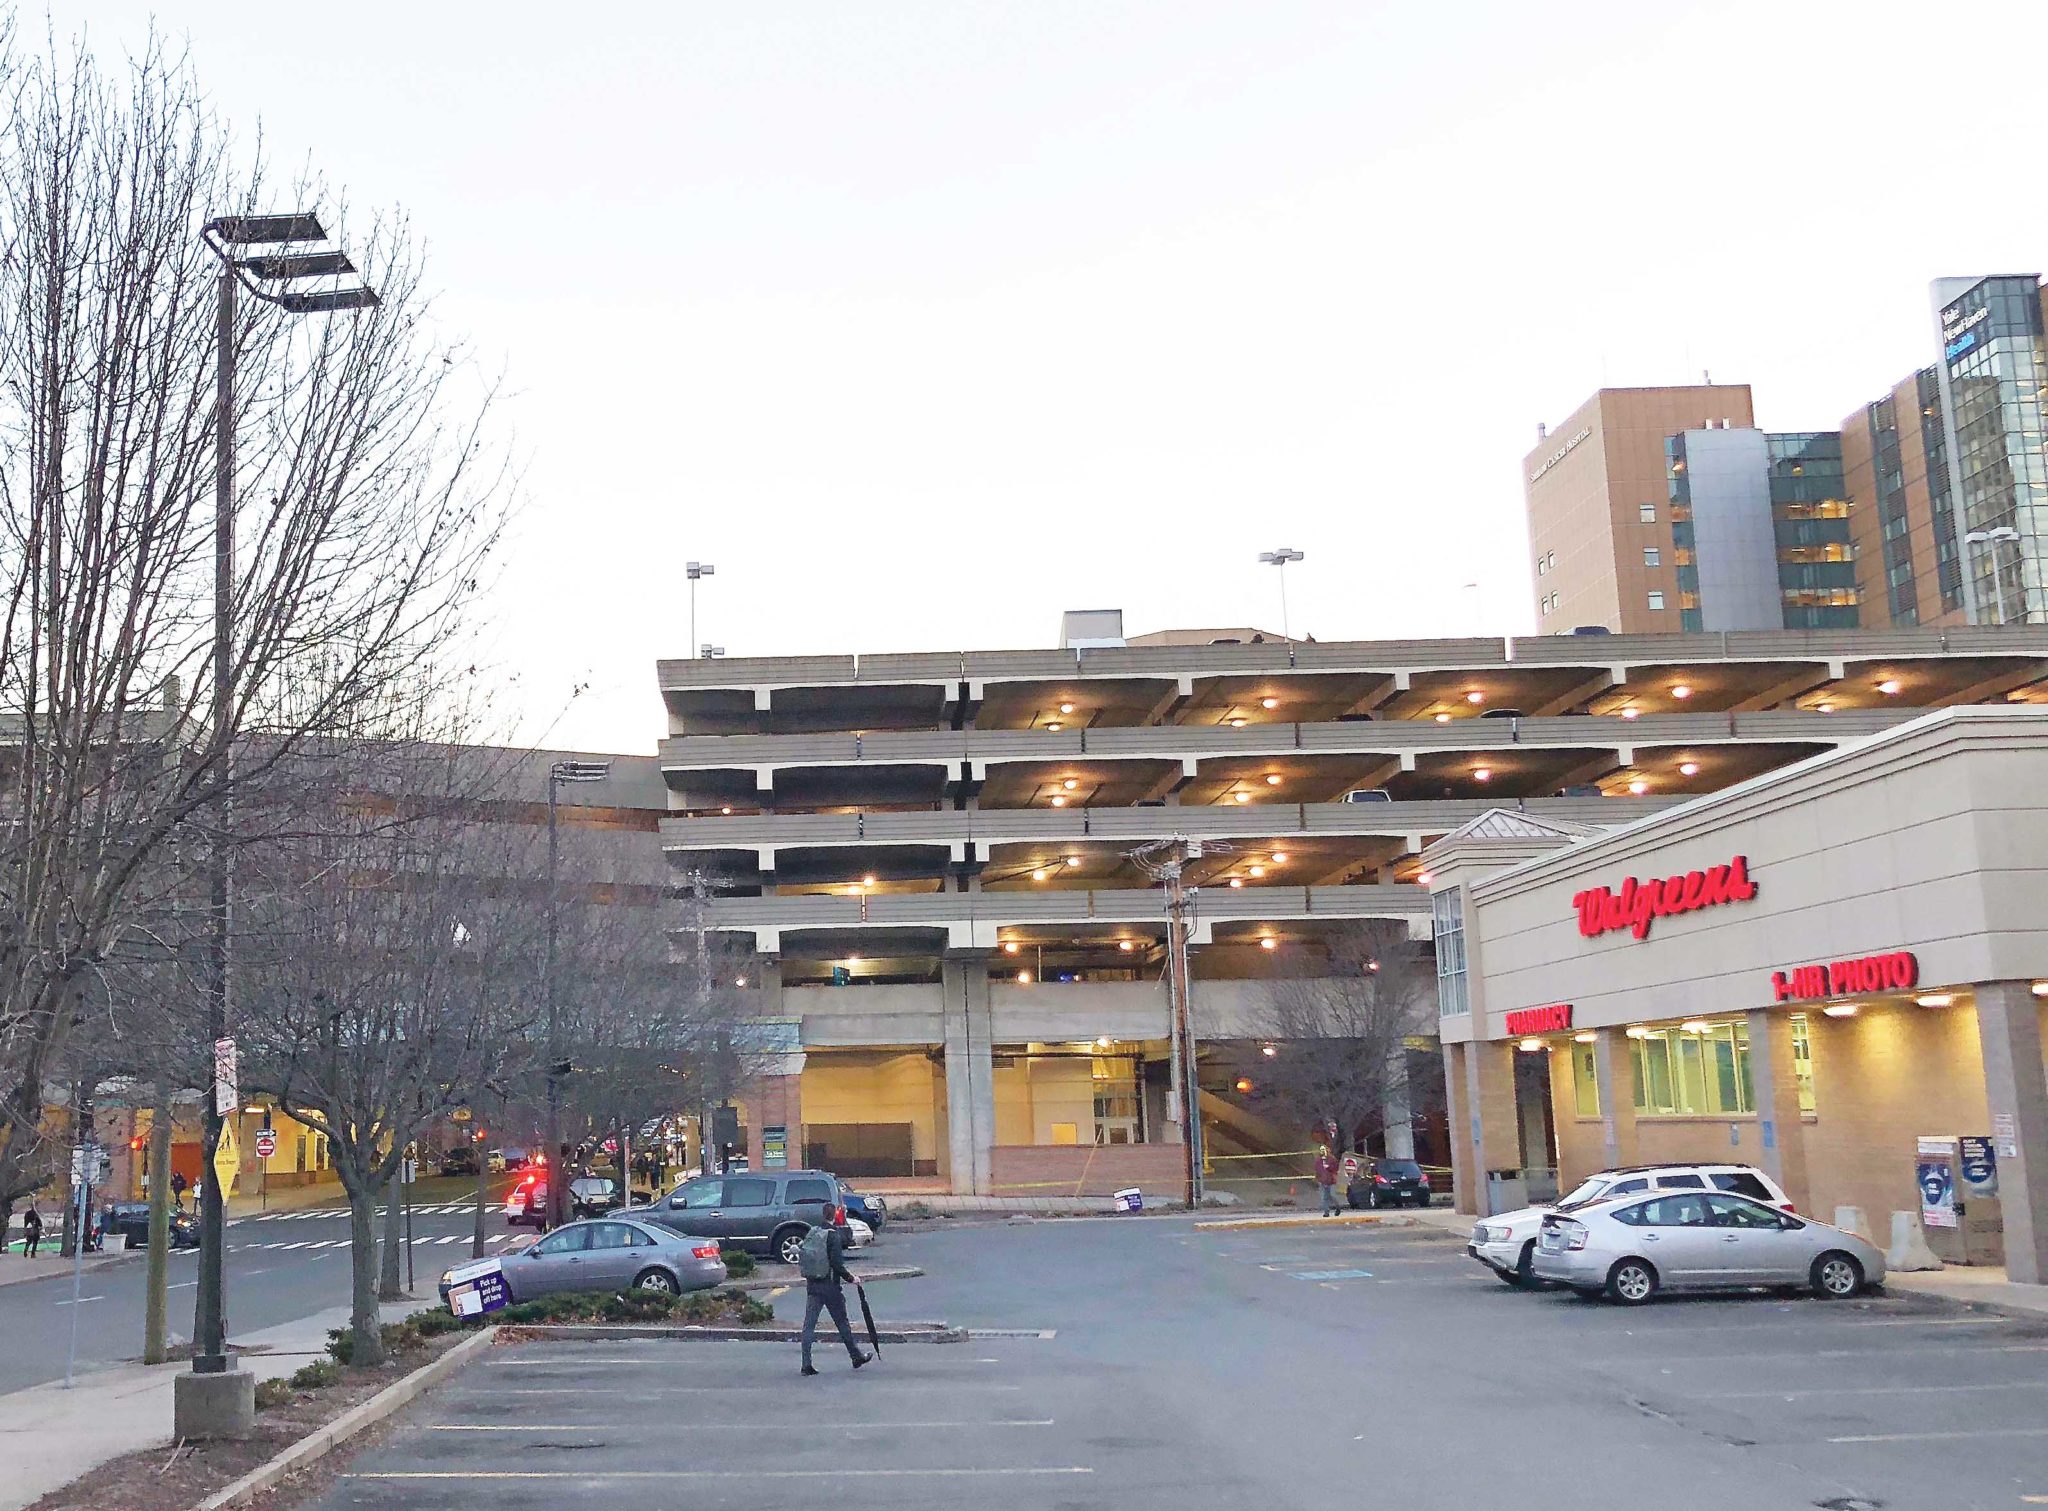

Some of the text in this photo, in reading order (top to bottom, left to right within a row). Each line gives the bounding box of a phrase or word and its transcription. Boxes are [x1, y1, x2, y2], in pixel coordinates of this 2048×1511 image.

[1942, 309, 1960, 326] Yale
[1573, 855, 1759, 940] Walgreens
[1771, 951, 1919, 1001] 1-HR PHOTO
[1504, 1005, 1573, 1035] PHARMACY
[480, 1279, 491, 1288] Pick
[482, 1284, 502, 1296] and drop
